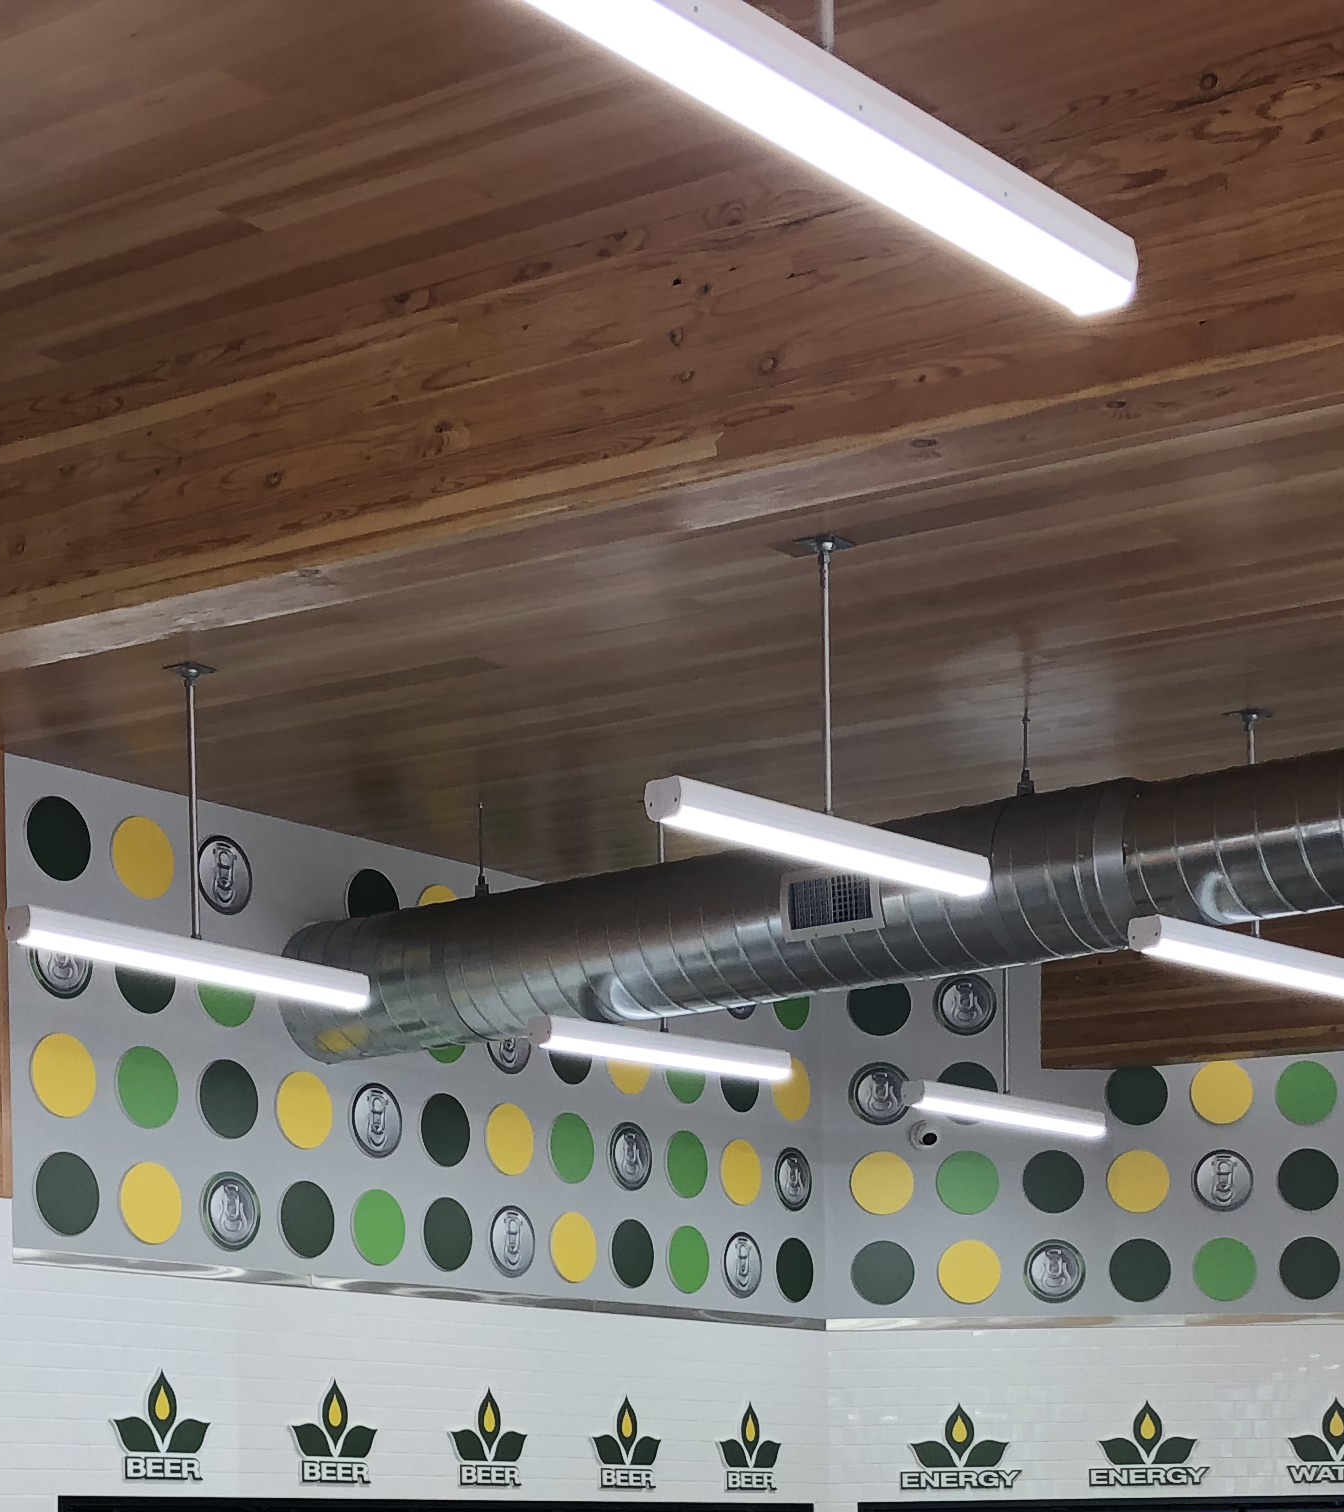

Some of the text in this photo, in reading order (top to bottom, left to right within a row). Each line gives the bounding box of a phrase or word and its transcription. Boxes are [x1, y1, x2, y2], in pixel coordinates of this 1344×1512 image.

[126, 1457, 202, 1480] BEER
[302, 1460, 370, 1483] BEER
[460, 1464, 521, 1486] BEER
[600, 1467, 656, 1488] BEER
[1089, 1466, 1209, 1486] ENERGY
[727, 1470, 776, 1490] BEER
[901, 1470, 1022, 1489] ENERGY
